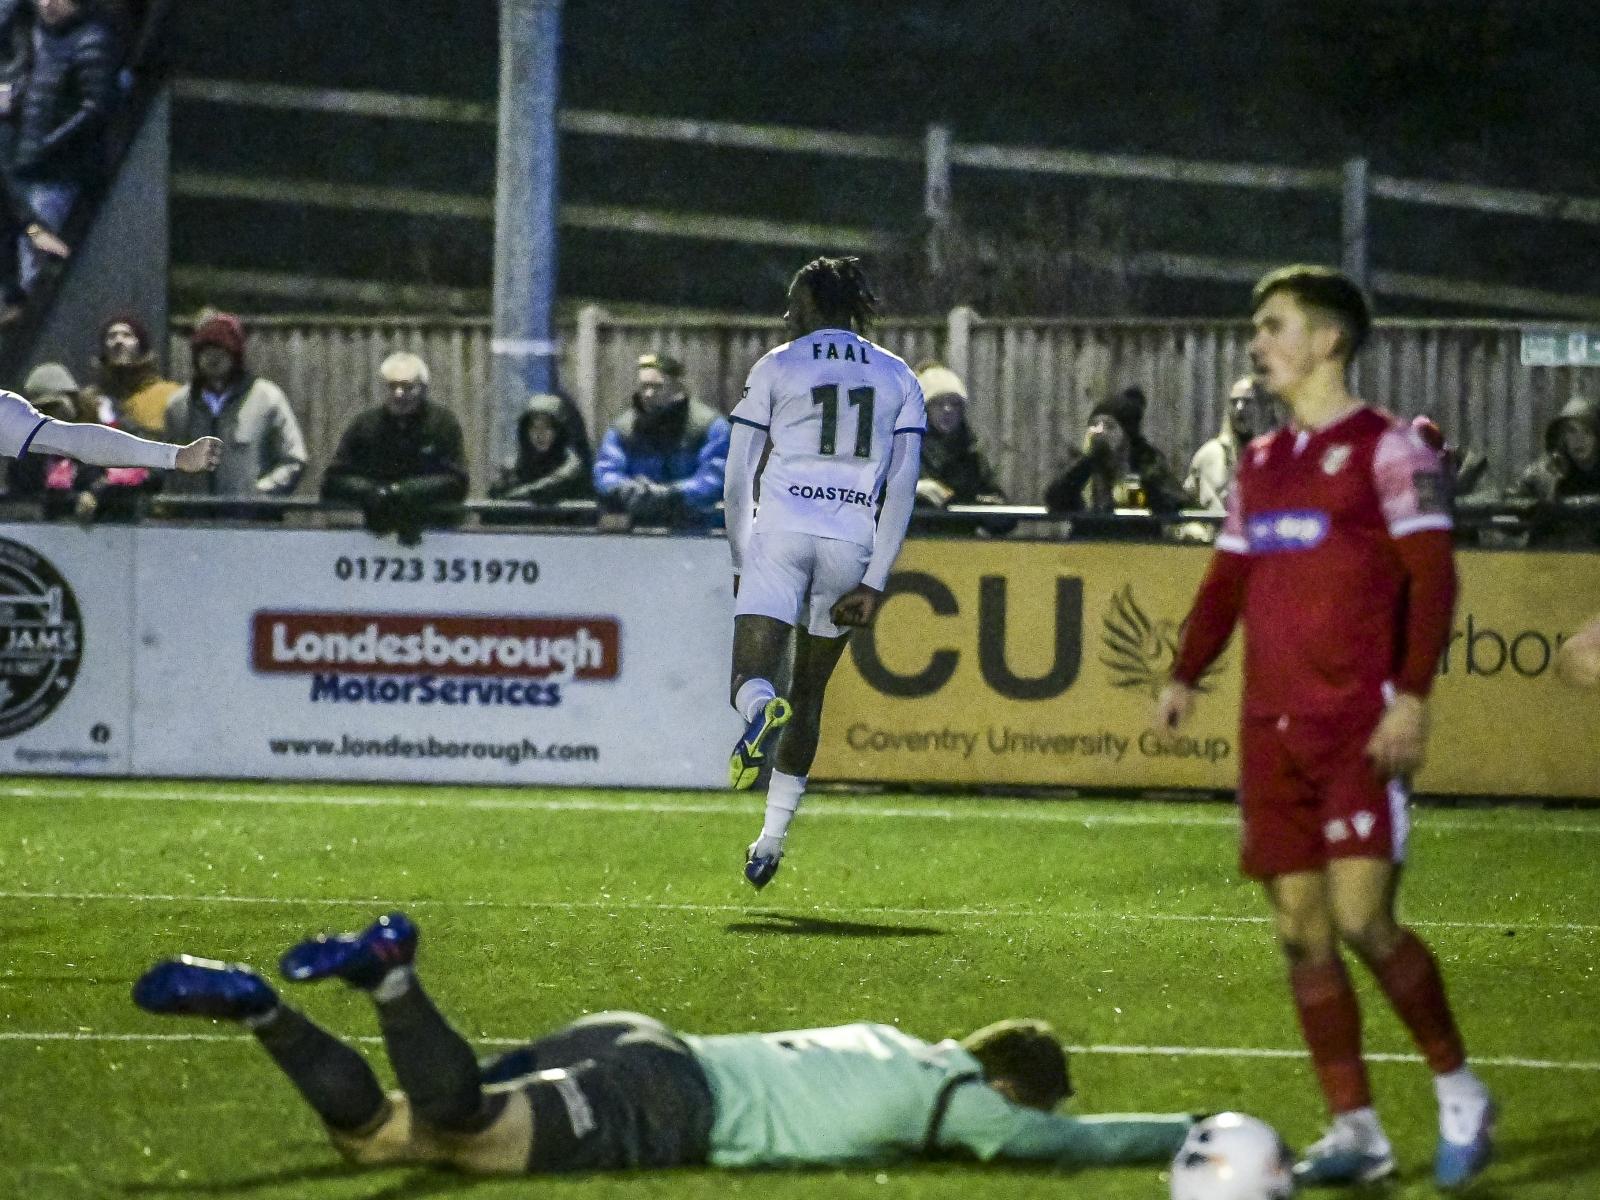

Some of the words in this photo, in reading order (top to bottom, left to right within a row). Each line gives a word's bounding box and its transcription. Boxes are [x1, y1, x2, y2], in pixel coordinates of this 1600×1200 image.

[813, 343, 870, 364] FAAL
[811, 383, 876, 458] 11
[335, 555, 424, 582] 01723
[433, 558, 540, 584] 351970
[271, 622, 603, 683] Londesborough
[848, 570, 1084, 701] CU
[269, 734, 600, 764] www.londesborough.com
[846, 722, 978, 760] Coventry
[987, 726, 1129, 762] University
[1138, 728, 1232, 764] Group
